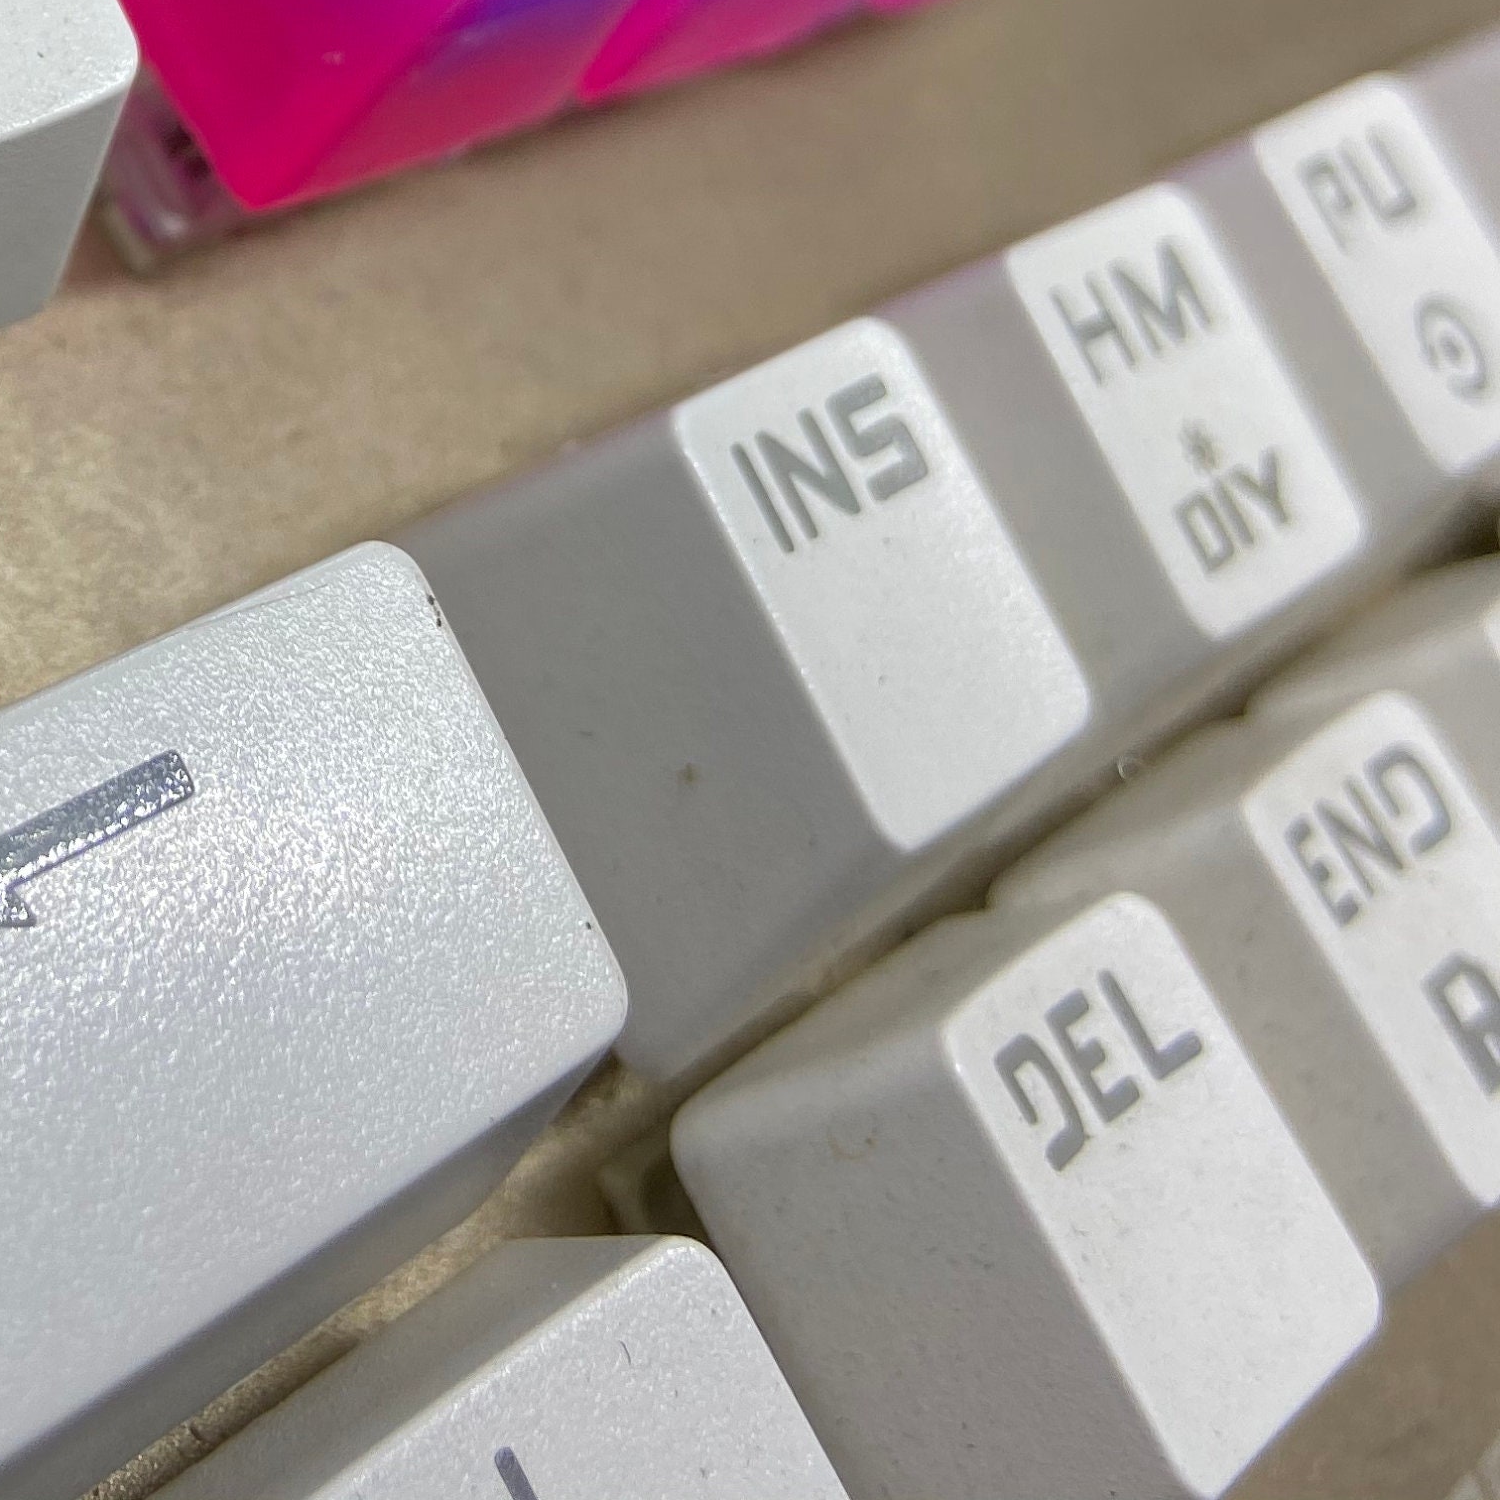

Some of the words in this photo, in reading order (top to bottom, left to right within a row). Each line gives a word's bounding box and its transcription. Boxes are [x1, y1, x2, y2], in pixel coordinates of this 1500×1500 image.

[1300, 128, 1419, 253] PU
[1051, 237, 1212, 386] HM
[729, 373, 929, 554] INS
[1285, 742, 1452, 929] END
[994, 970, 1203, 1172] DEL
